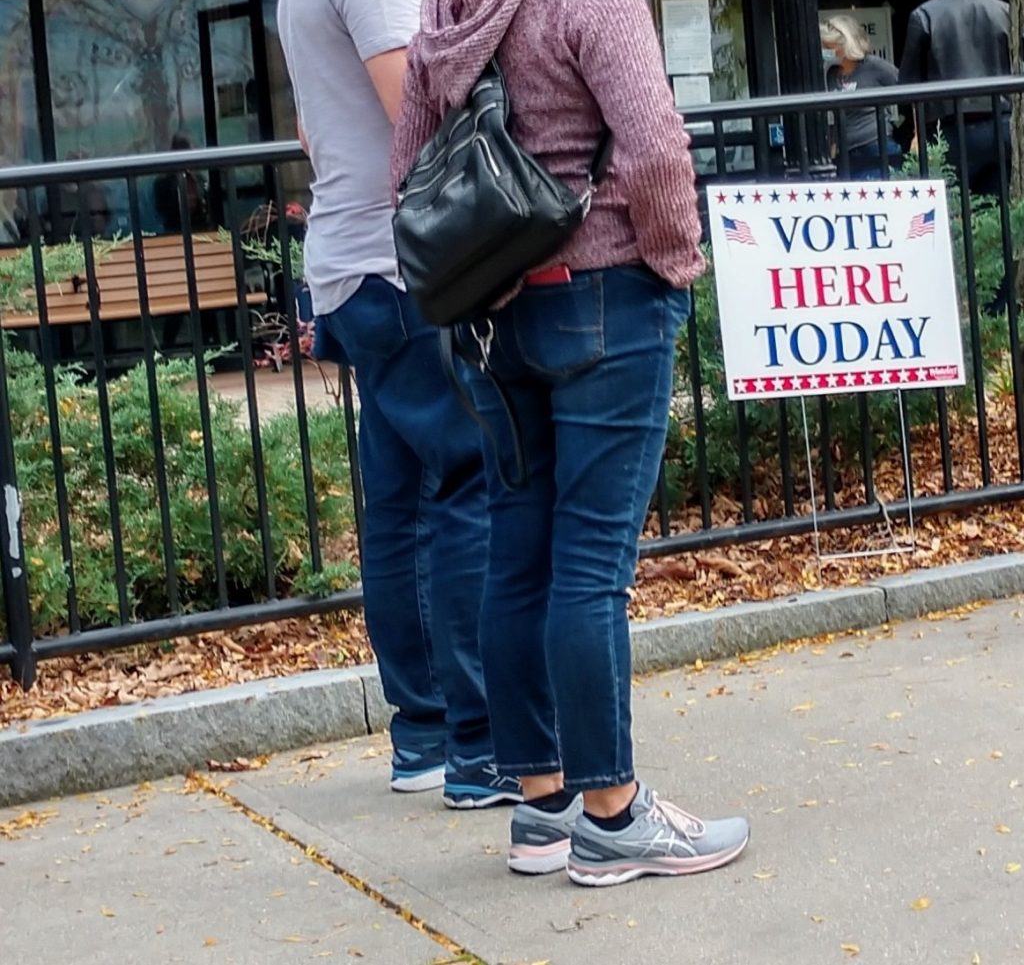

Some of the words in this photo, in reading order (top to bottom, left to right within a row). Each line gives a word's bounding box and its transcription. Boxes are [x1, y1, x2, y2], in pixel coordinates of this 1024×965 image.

[768, 213, 893, 253] VOTE
[767, 262, 909, 310] HERE
[754, 316, 931, 368] TODAY
